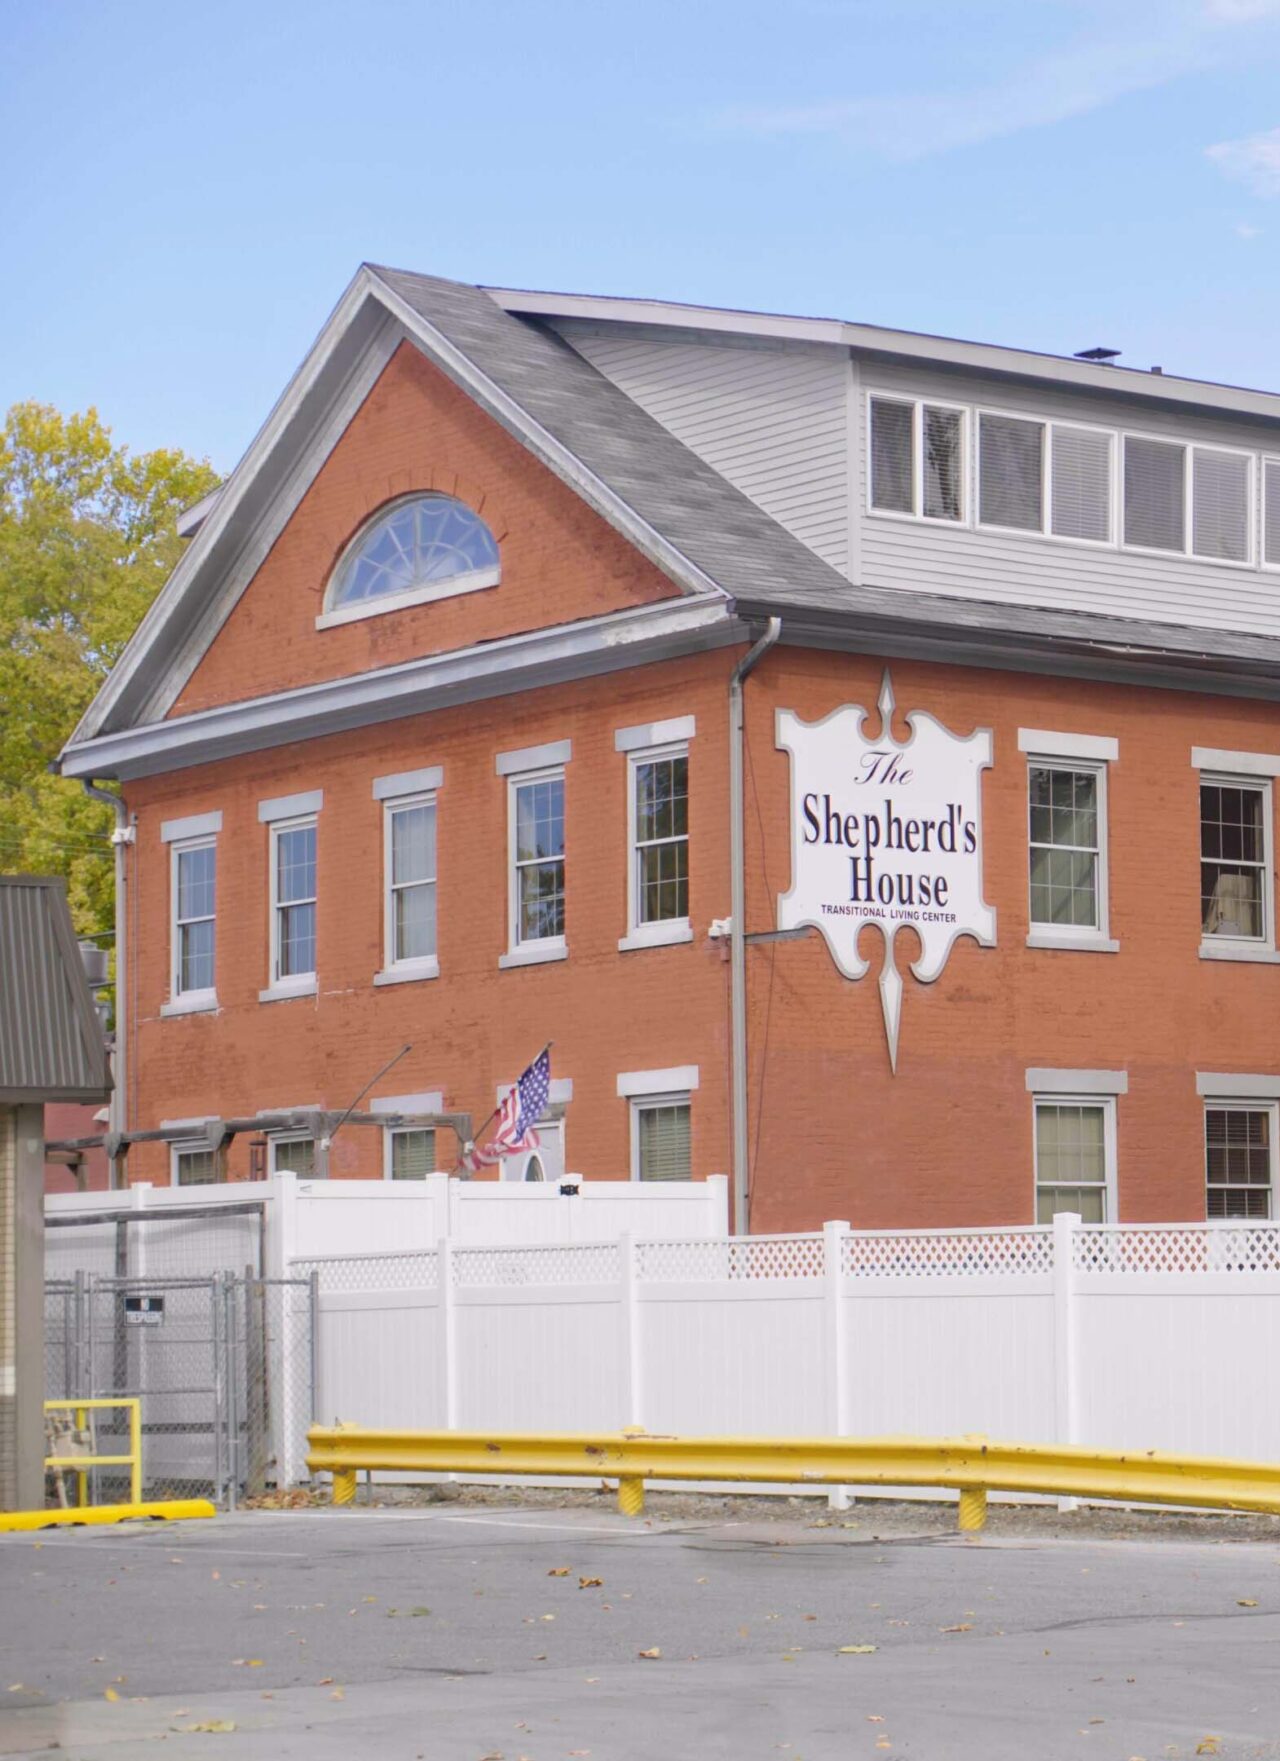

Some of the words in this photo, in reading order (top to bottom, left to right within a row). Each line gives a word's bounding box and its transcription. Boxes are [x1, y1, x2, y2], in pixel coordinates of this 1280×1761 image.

[853, 751, 914, 785] The
[802, 793, 976, 859] Shepherd's
[848, 856, 949, 907] House
[821, 904, 886, 918] TRANSITIONAL
[890, 909, 919, 921] LIVING
[922, 912, 957, 923] CENTER
